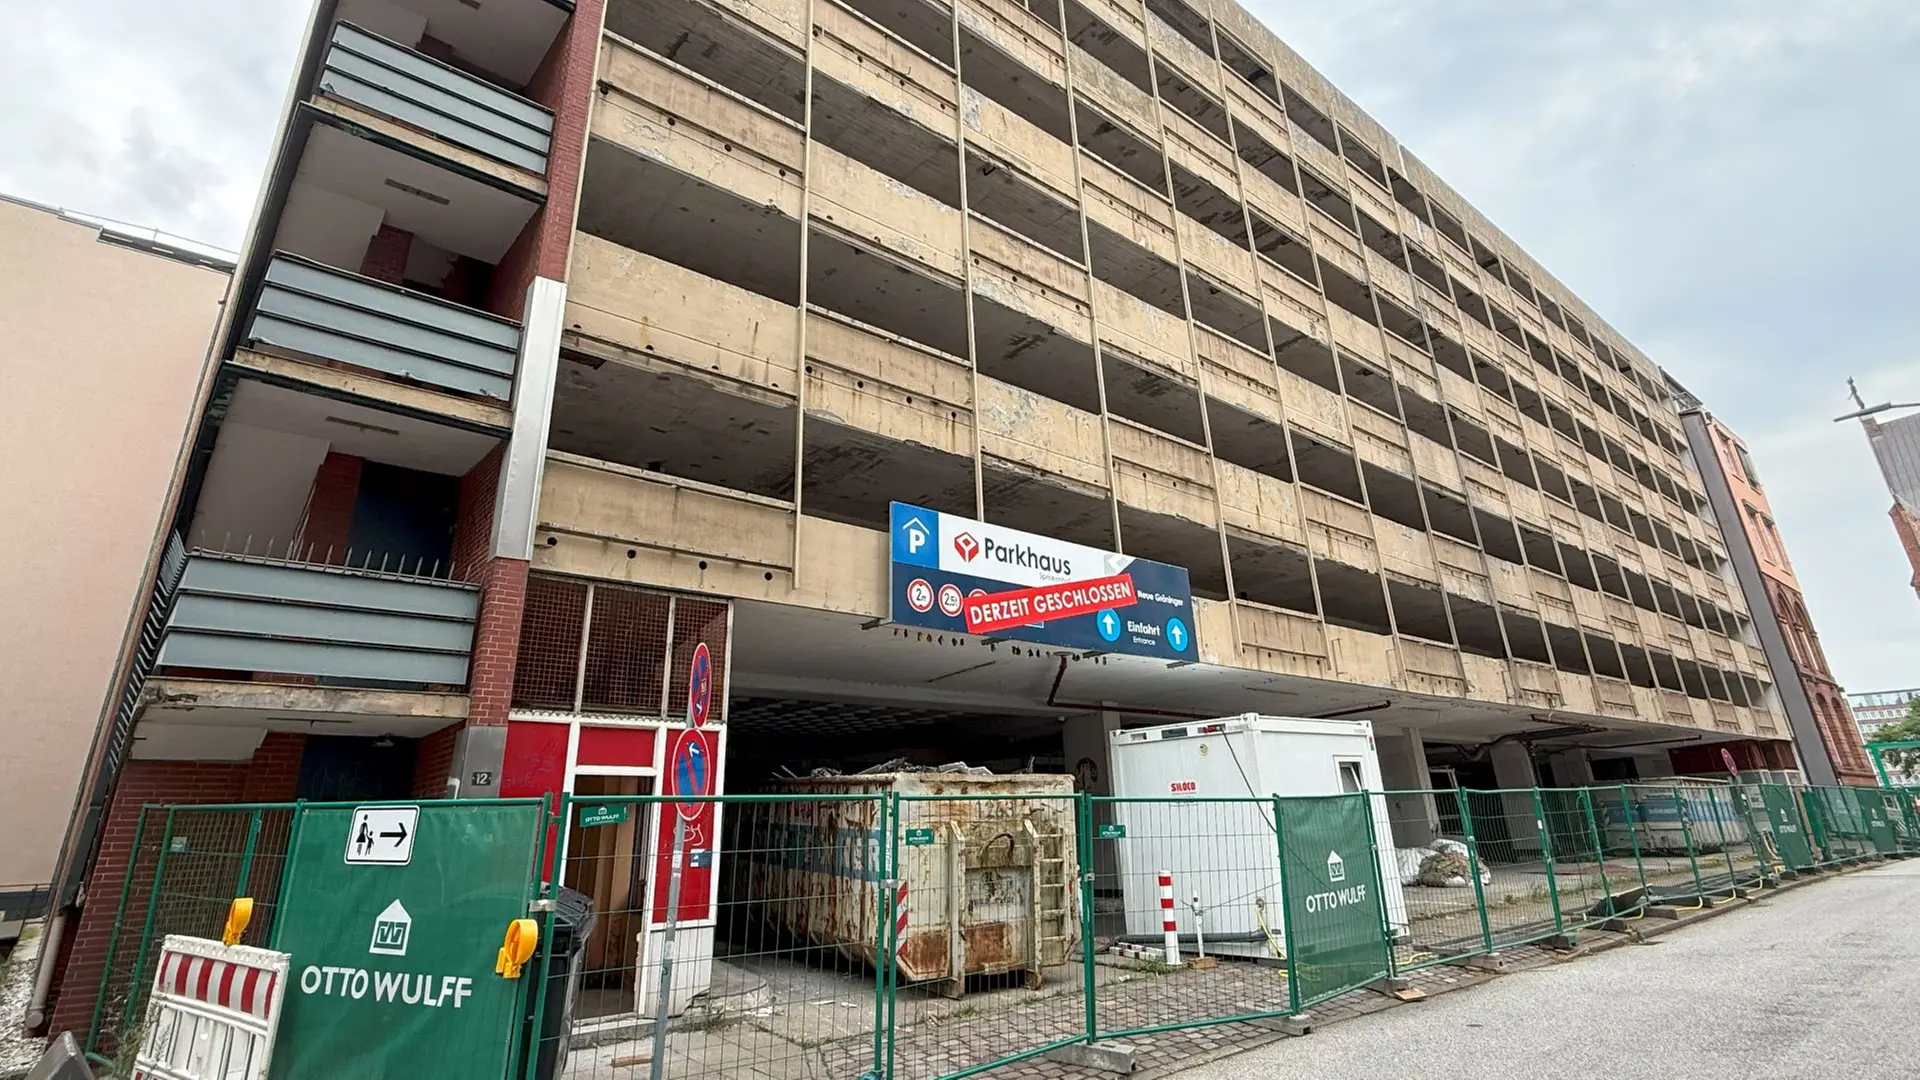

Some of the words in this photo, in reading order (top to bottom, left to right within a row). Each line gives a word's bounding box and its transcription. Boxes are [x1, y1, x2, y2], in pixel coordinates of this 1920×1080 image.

[909, 529, 926, 554] P
[984, 537, 1071, 576] Parkhaus
[970, 598, 1029, 625] DERZEIT
[1034, 581, 1131, 614] GESCHLOSSEN
[1137, 589, 1154, 601] Neue
[1127, 620, 1161, 636] Einfahrt
[1133, 636, 1156, 646] Entrance
[475, 773, 488, 785] 12
[1306, 891, 1337, 913] OTTO
[1337, 884, 1366, 907] WULFF
[300, 965, 369, 1000] OTTO
[374, 970, 472, 1008] WULFF
